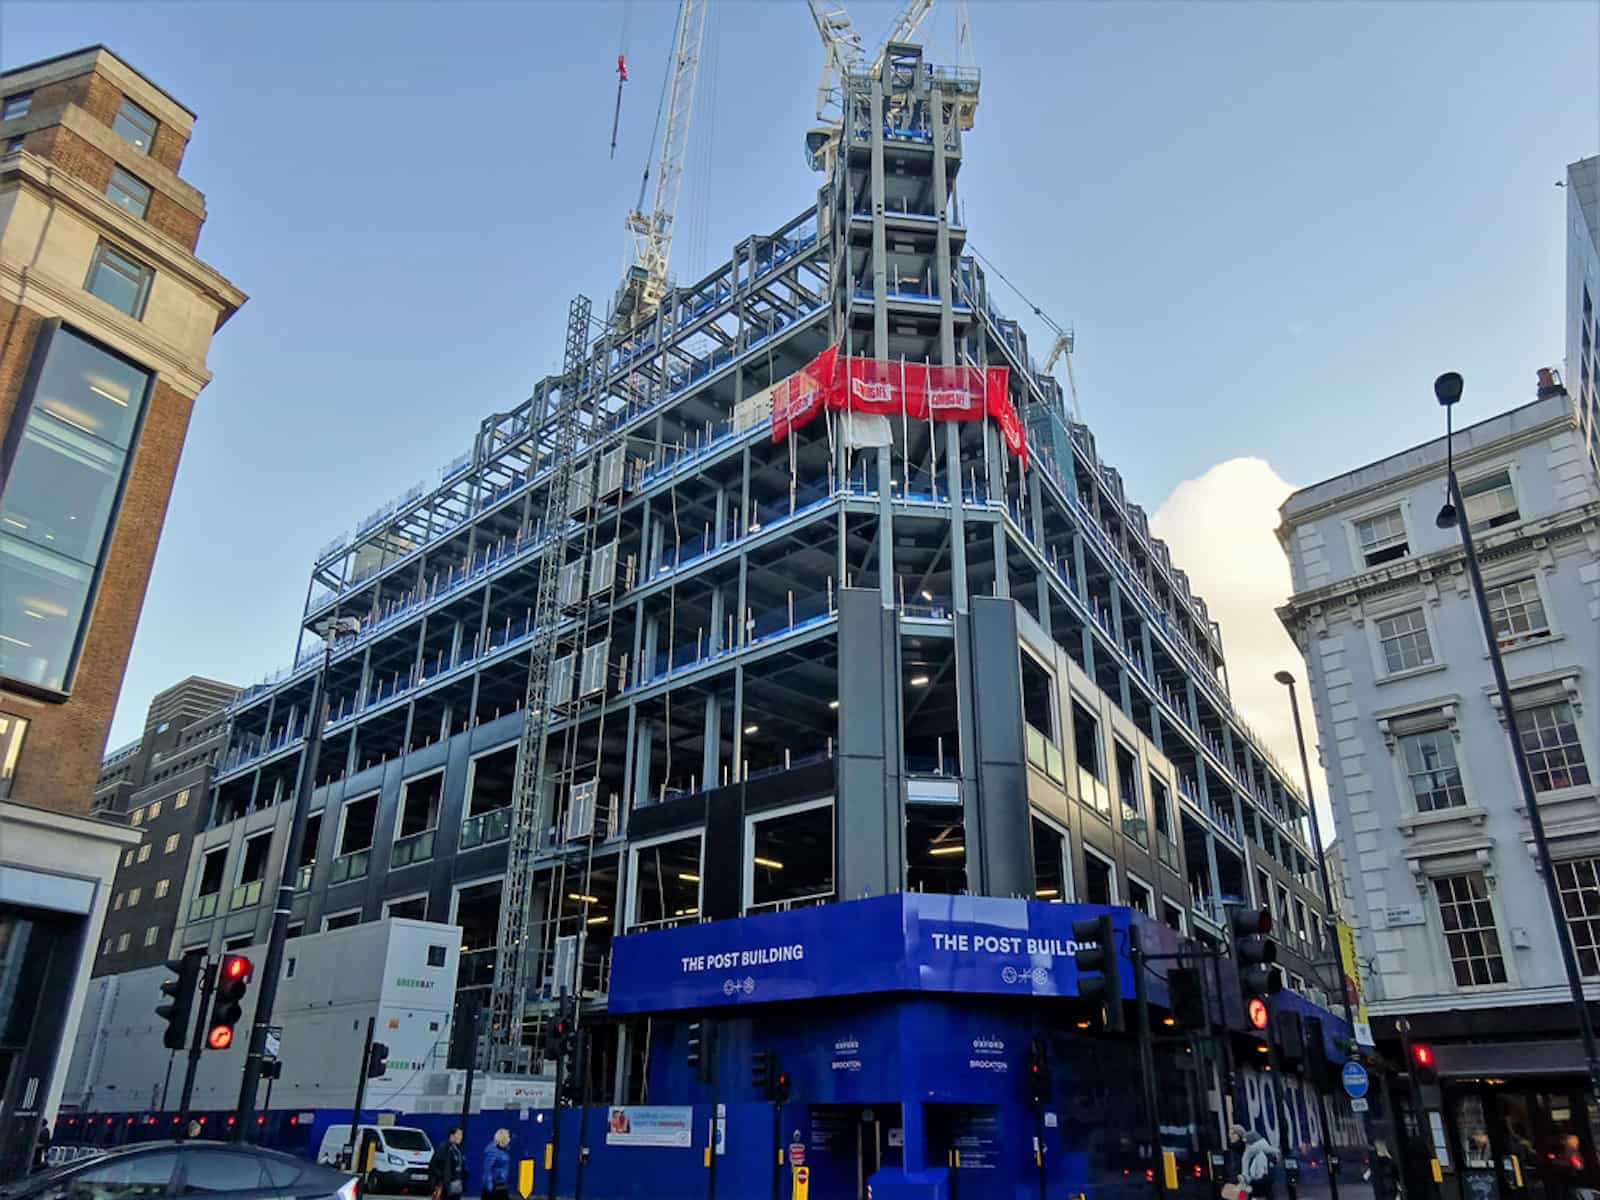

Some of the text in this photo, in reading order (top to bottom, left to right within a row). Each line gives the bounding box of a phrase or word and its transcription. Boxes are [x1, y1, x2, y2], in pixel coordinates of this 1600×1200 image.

[932, 934, 968, 951] THE
[974, 936, 1022, 954] POST
[681, 944, 804, 972] THE POST BUILDING
